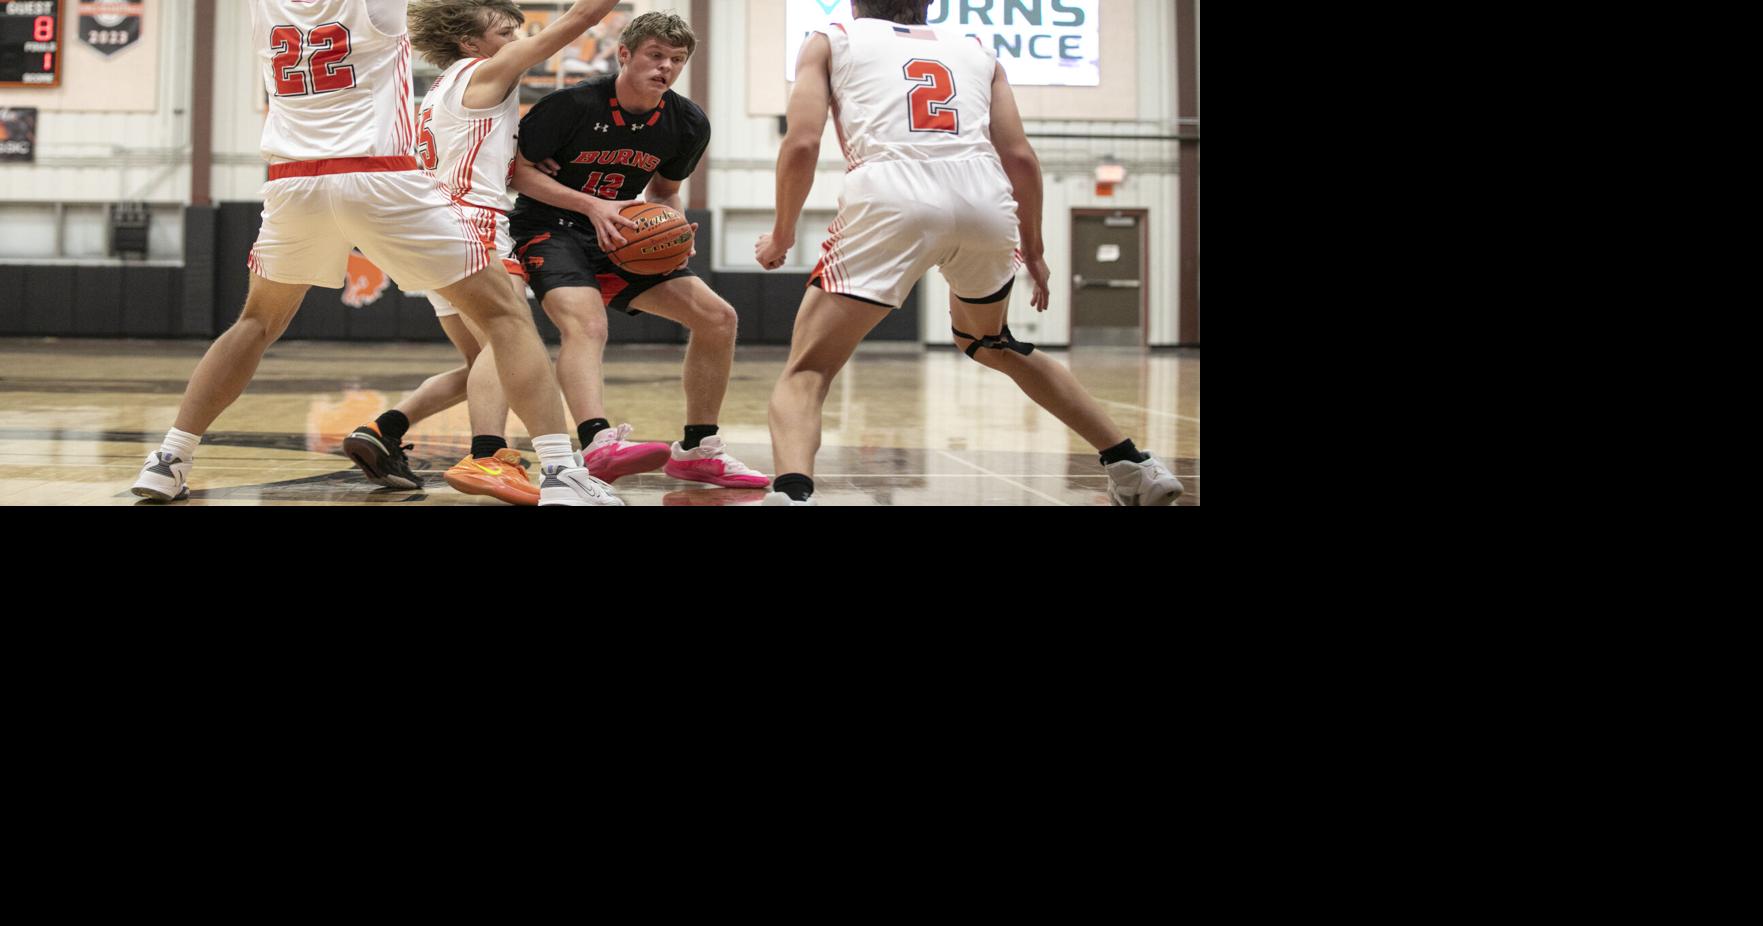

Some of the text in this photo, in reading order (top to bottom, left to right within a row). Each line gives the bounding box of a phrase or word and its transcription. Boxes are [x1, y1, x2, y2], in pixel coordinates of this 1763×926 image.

[6, 1, 53, 15] GUEST
[927, 0, 1086, 27] URNS
[33, 15, 54, 42] 8
[88, 30, 129, 45] 2023
[270, 21, 357, 97] 22
[903, 58, 959, 135] 2
[569, 148, 661, 173] BURNS
[580, 171, 625, 199] 12
